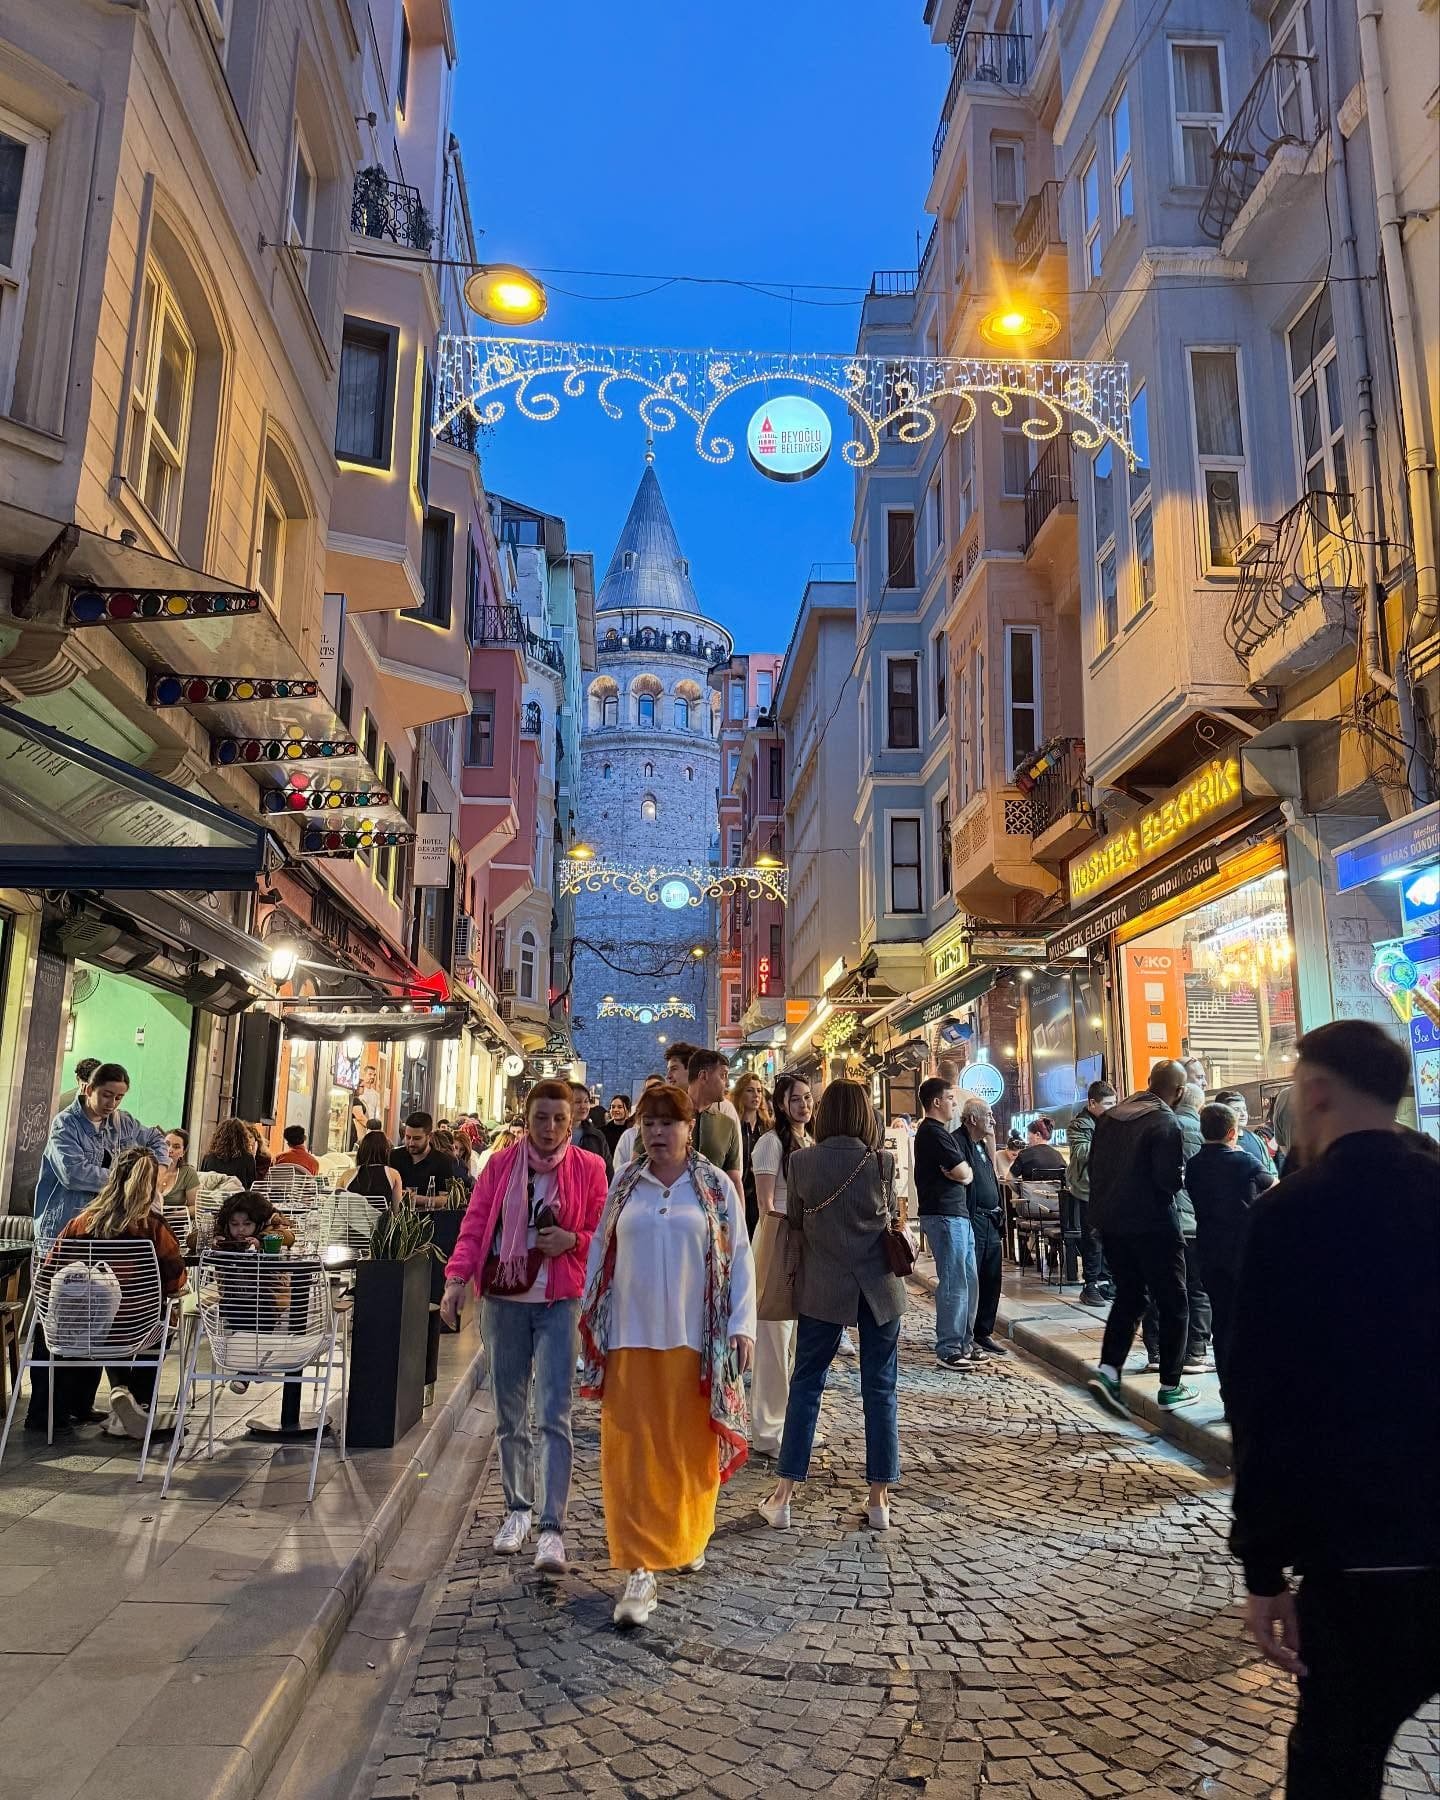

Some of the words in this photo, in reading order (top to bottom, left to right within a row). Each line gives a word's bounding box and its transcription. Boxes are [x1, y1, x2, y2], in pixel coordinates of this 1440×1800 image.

[781, 427, 821, 443] BEYOĞLU
[781, 442, 822, 454] BELEDİYESİ
[422, 838, 443, 846] HOTEL
[1048, 930, 1084, 961] MUSATEK
[1085, 903, 1127, 942] ELEKTRİK
